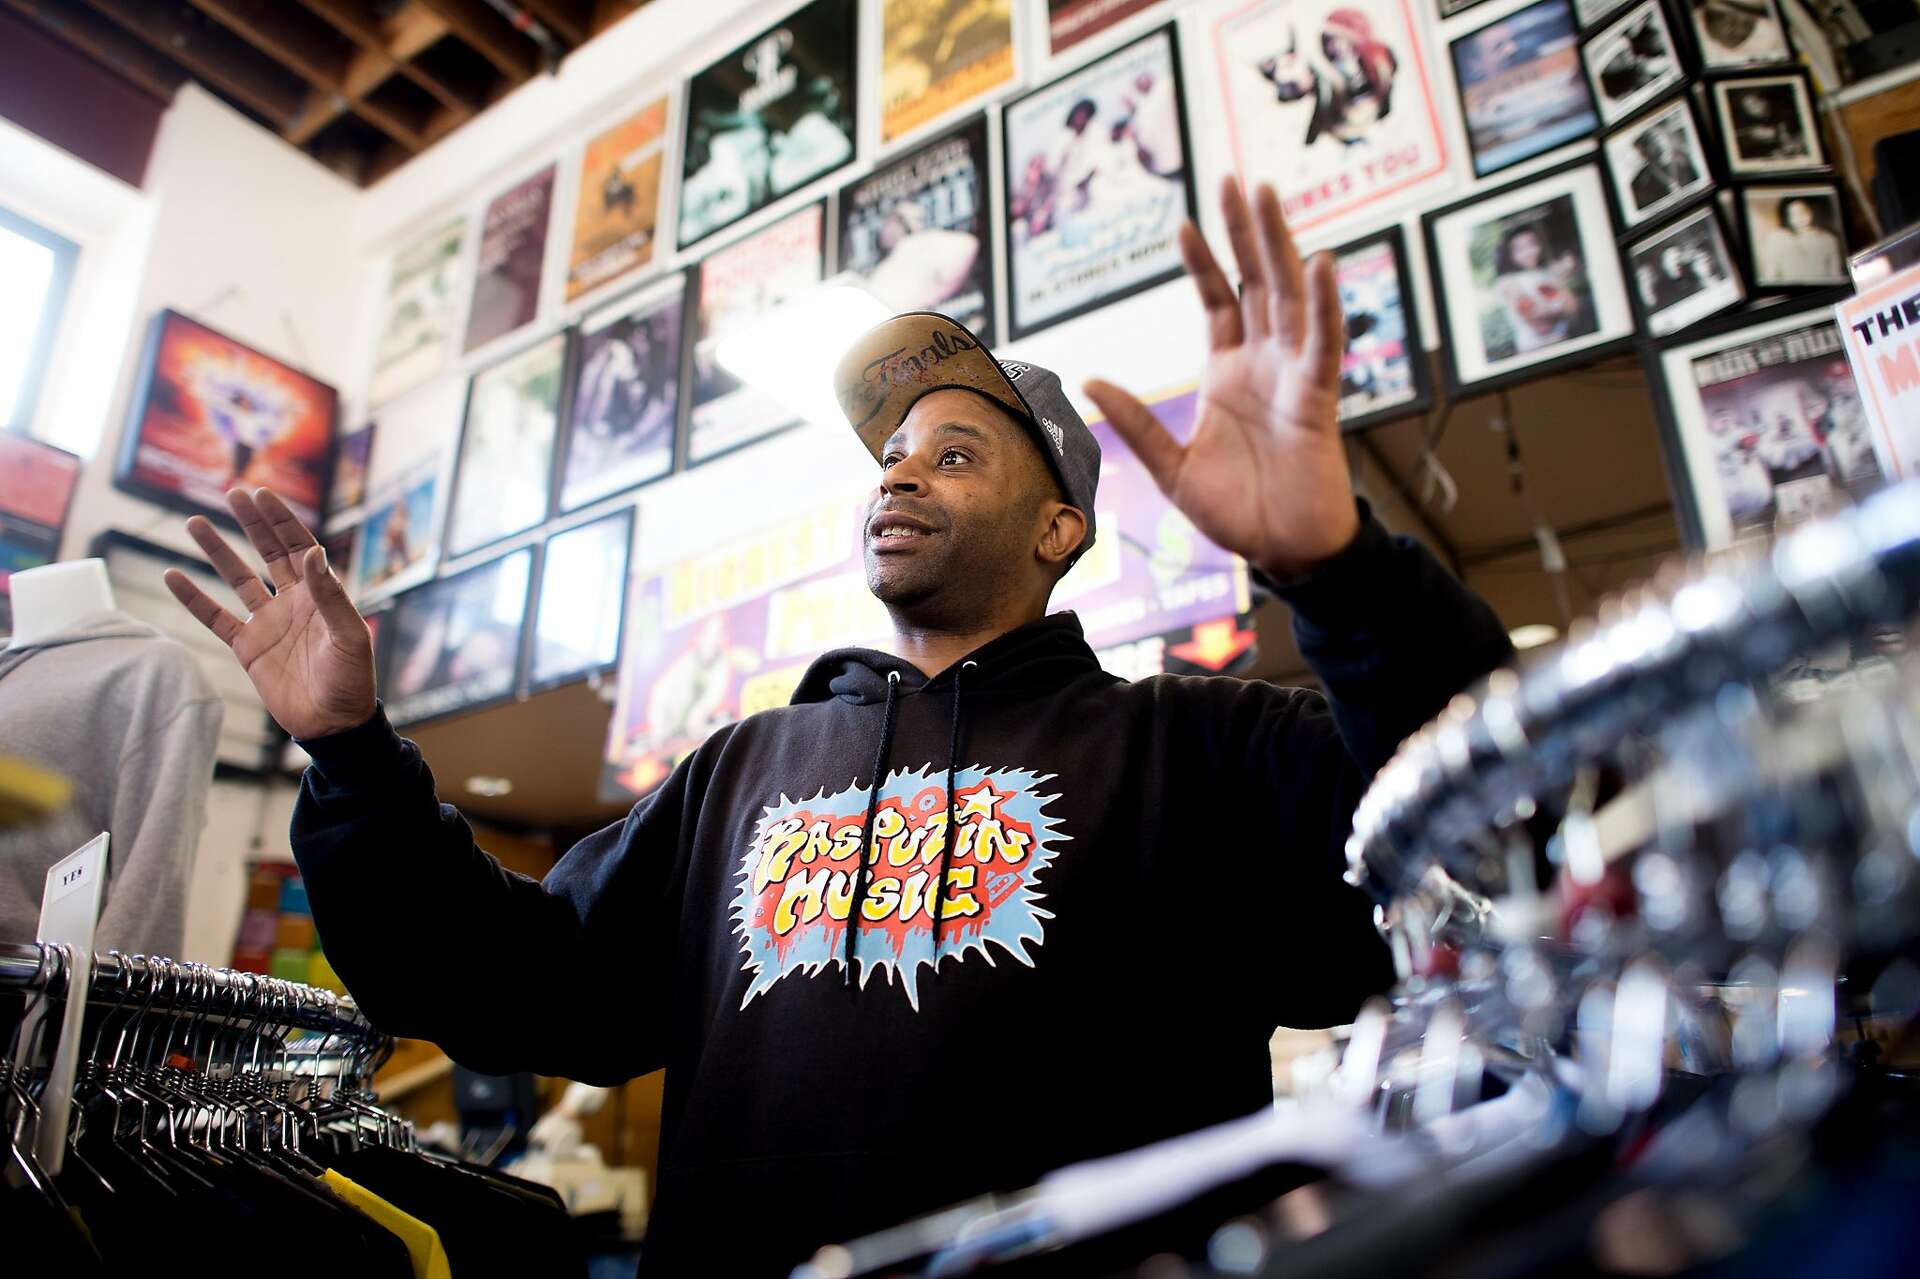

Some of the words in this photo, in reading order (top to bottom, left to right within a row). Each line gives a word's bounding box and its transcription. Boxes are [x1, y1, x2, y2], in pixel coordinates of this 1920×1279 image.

[63, 867, 83, 887] YES
[753, 793, 1032, 895] RASPUTIN
[772, 864, 982, 936] MUSIC
